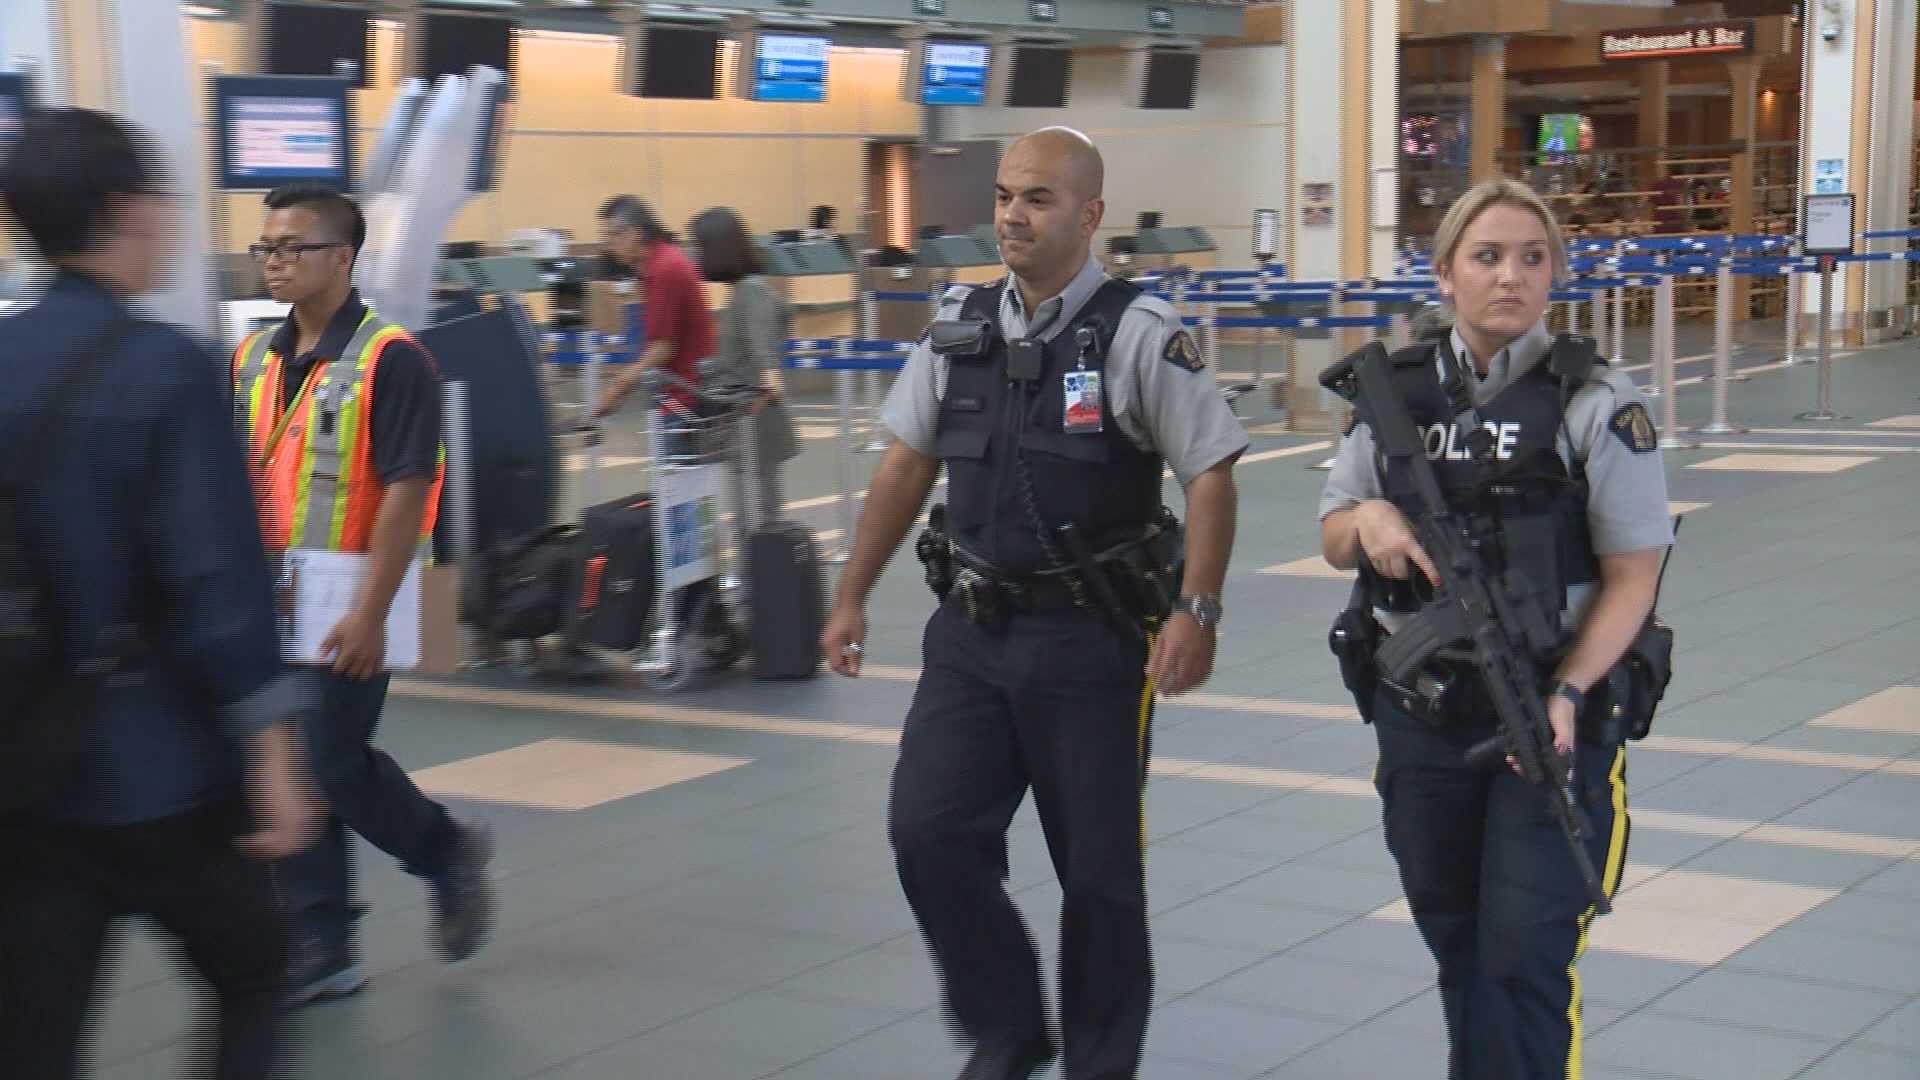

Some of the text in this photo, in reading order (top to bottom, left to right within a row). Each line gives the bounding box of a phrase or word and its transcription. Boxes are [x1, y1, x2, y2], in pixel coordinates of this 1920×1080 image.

[1602, 27, 1744, 53] Restaurant & Bar
[1416, 420, 1521, 461] OLE
